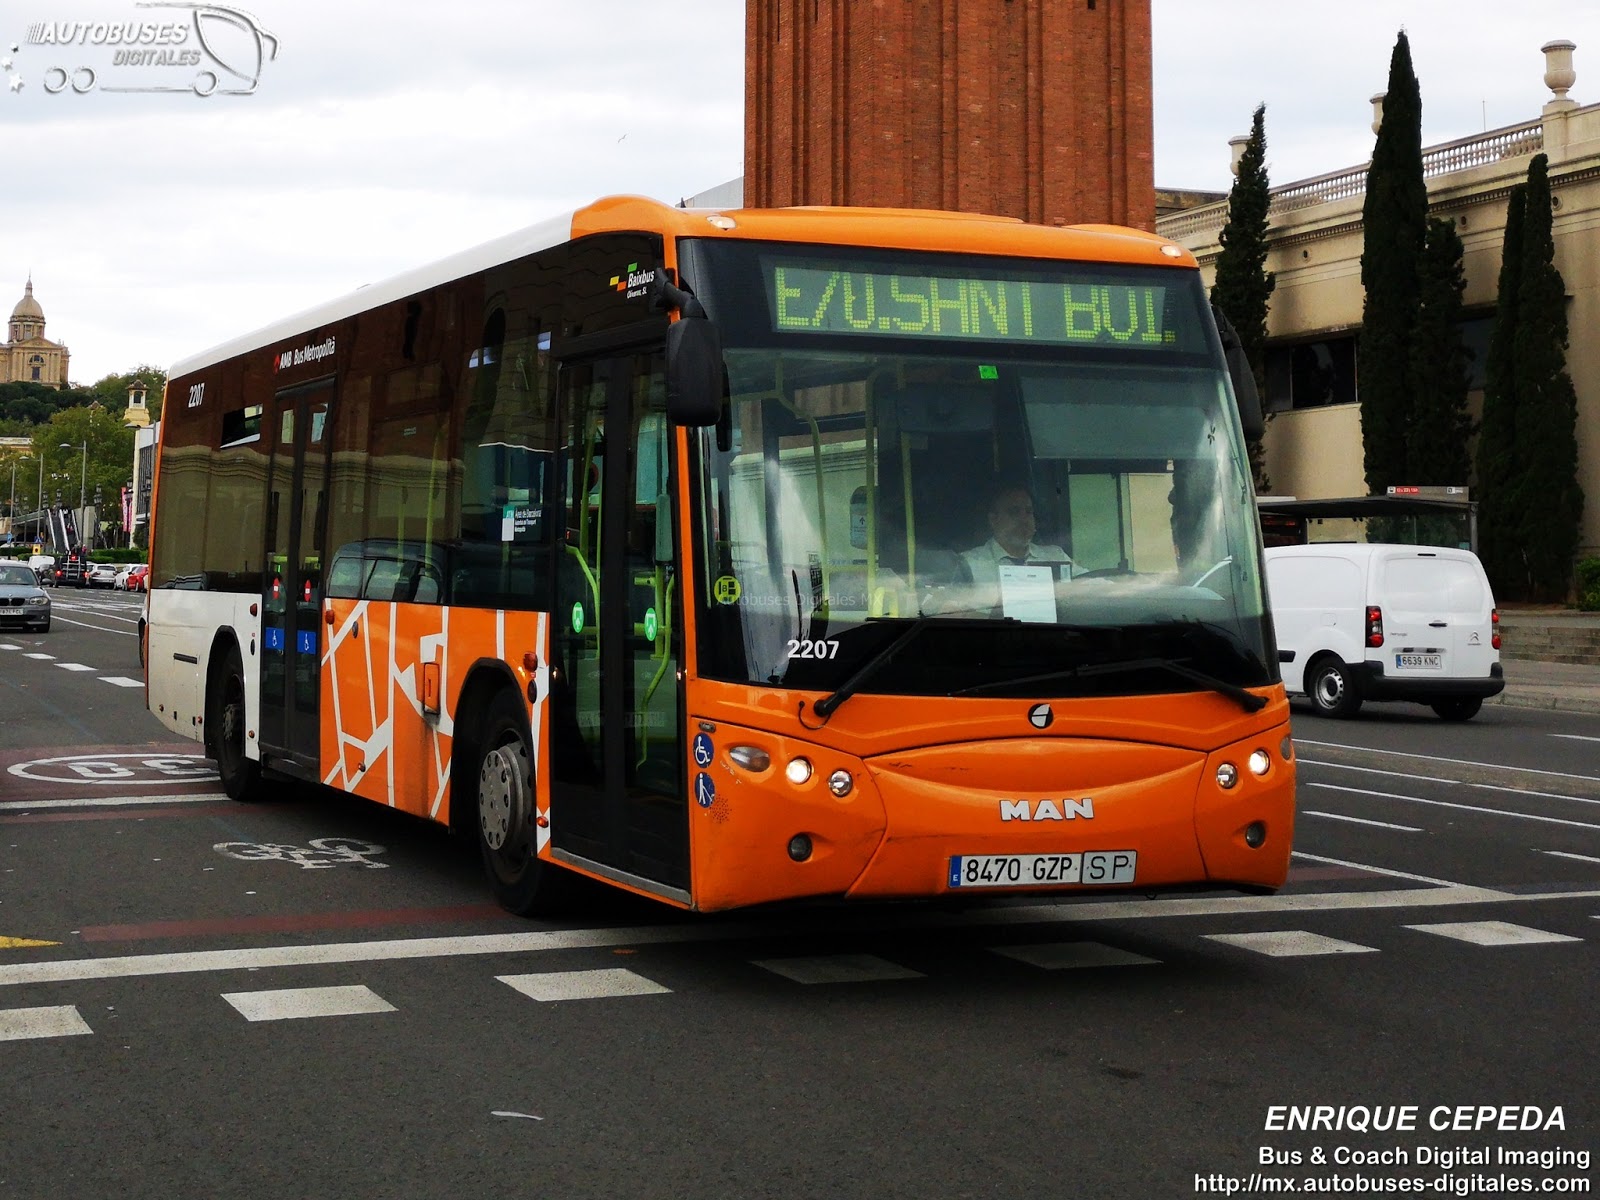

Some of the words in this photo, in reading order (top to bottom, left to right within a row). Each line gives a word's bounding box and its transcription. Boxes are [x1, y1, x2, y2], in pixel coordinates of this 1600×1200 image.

[628, 269, 655, 288] Baixbus
[279, 350, 292, 370] AMB
[293, 348, 304, 366] Bus
[188, 382, 205, 408] 2207
[787, 639, 840, 660] 2207
[1402, 656, 1422, 666] 6639
[1424, 656, 1439, 666] KNC
[999, 798, 1094, 821] MAN
[966, 858, 1021, 883] 8470
[1033, 857, 1073, 881] GZP
